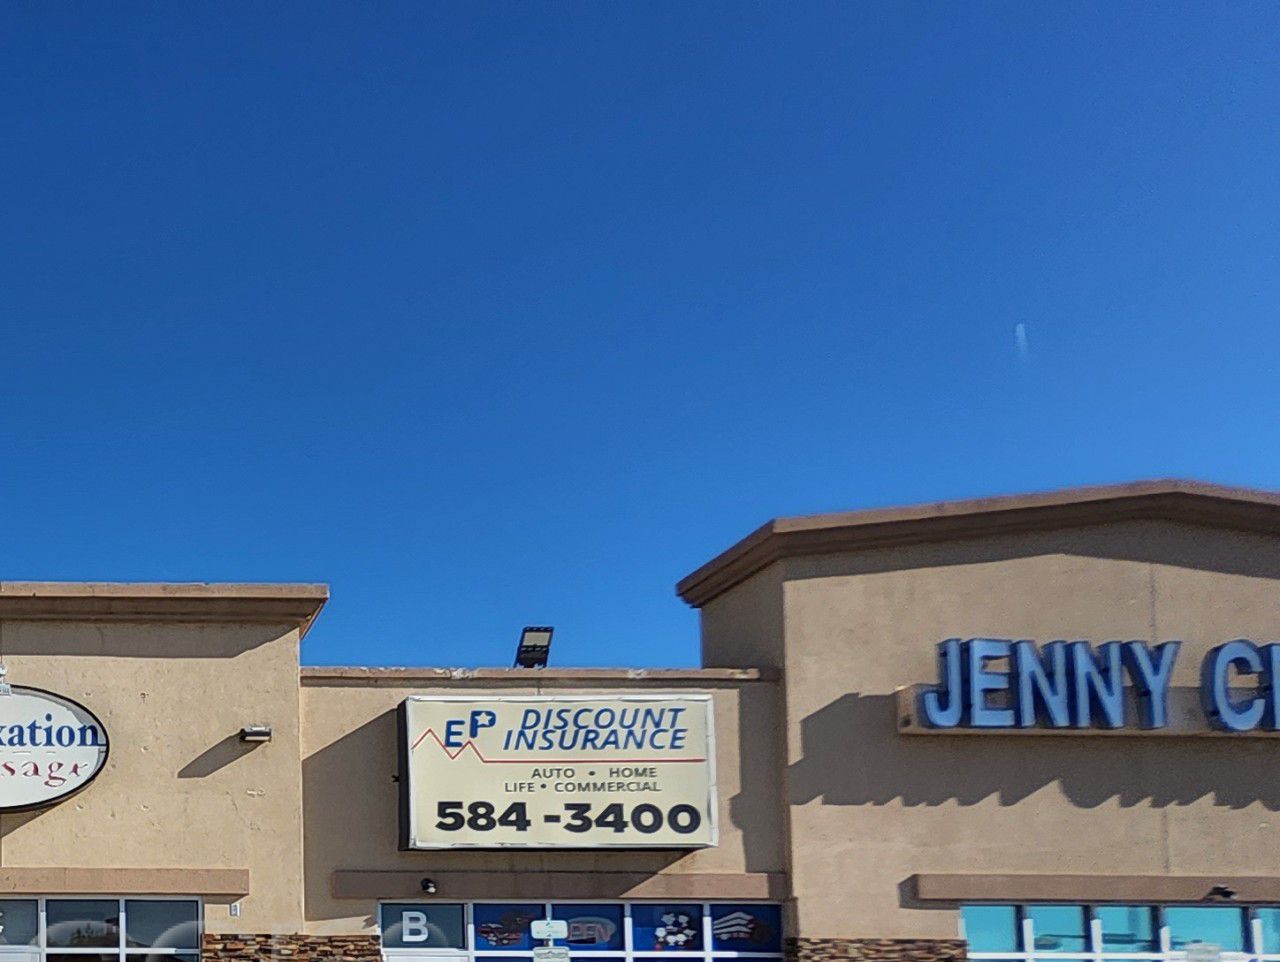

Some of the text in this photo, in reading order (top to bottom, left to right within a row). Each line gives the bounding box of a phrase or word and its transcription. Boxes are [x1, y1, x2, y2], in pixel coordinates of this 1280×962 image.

[921, 638, 1182, 729] JENNY
[444, 710, 497, 748] EP
[521, 708, 686, 730] DISCOUNT
[503, 728, 688, 750] INSURANCE
[531, 768, 657, 779] AUTO HOME
[505, 782, 661, 792] LIFE COMMERCIAL
[402, 911, 429, 942] B
